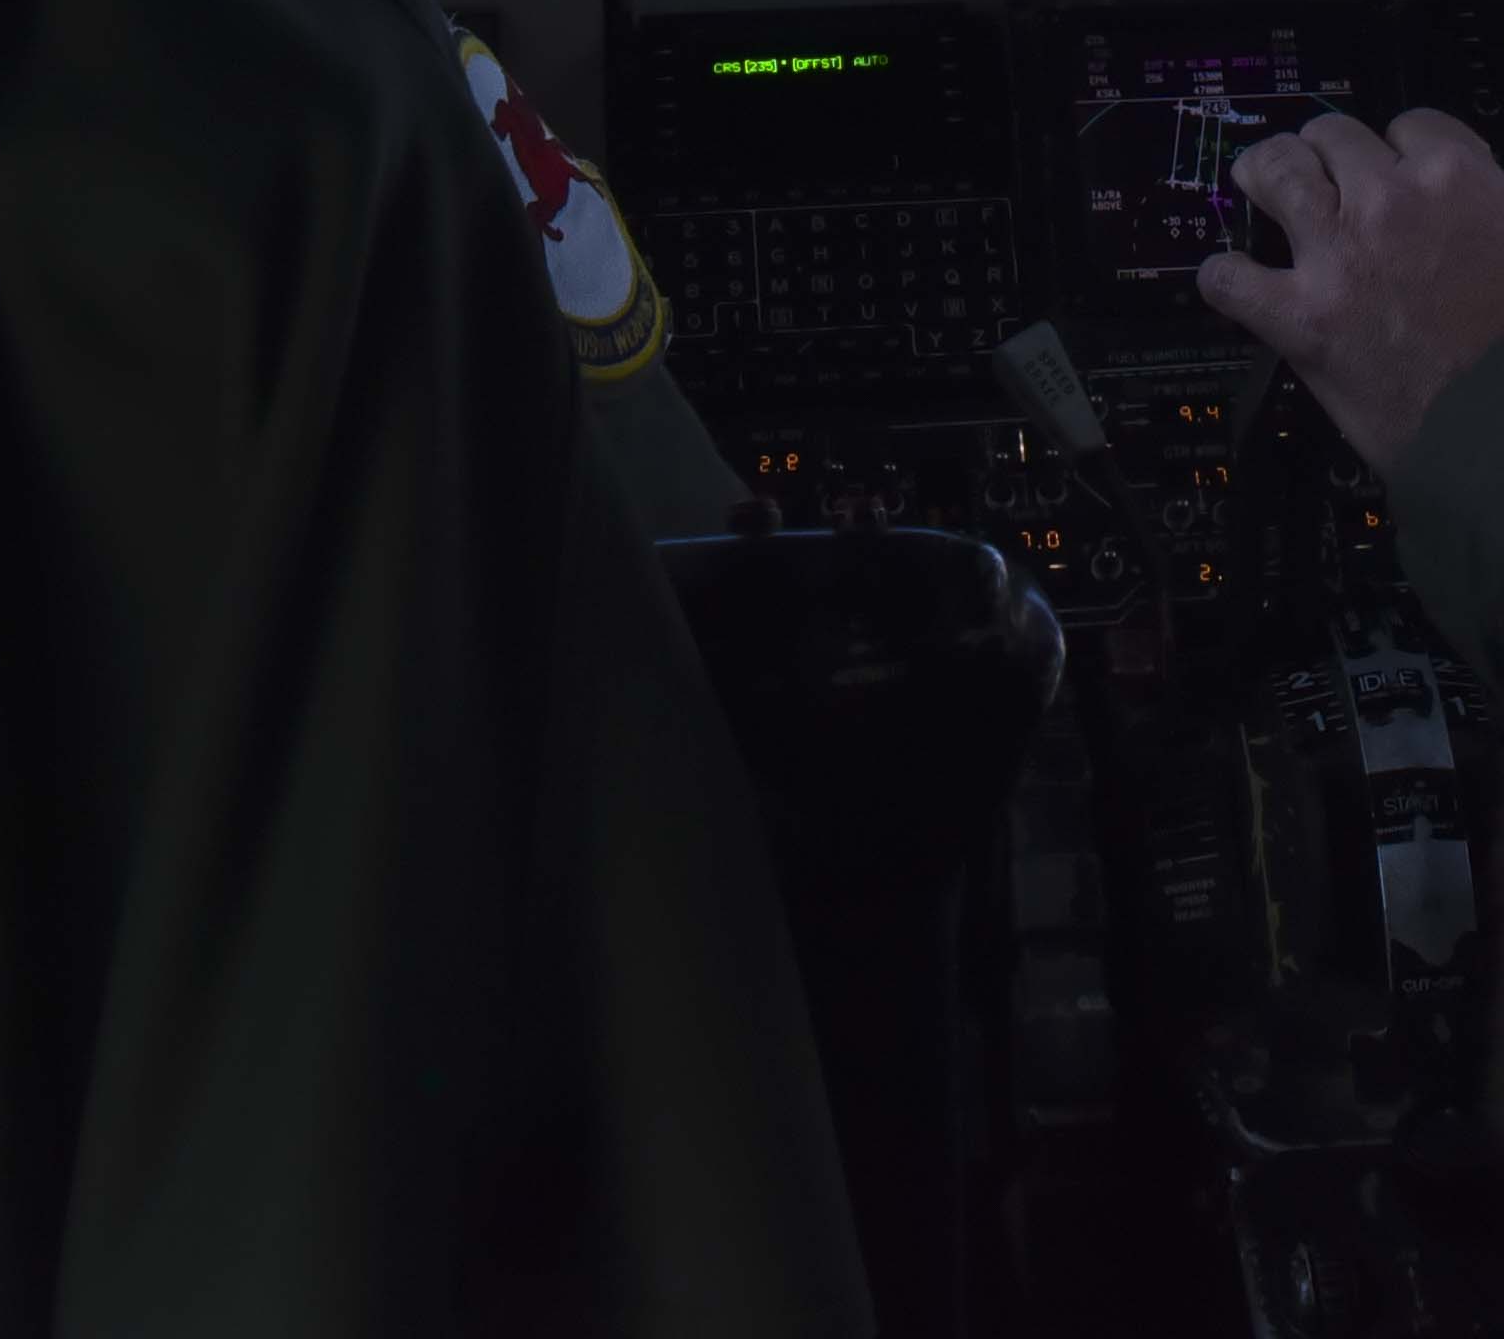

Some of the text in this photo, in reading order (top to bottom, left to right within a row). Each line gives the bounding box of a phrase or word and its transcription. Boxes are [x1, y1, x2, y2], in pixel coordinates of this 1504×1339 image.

[713, 62, 741, 74] CRS
[853, 54, 888, 67] AUTO
[896, 211, 912, 227] D
[812, 245, 829, 262] H
[984, 236, 998, 254] L
[971, 329, 987, 346] Z
[1178, 404, 1222, 425] 9.4
[1020, 529, 1061, 551] 7.0
[1289, 671, 1314, 692] 2
